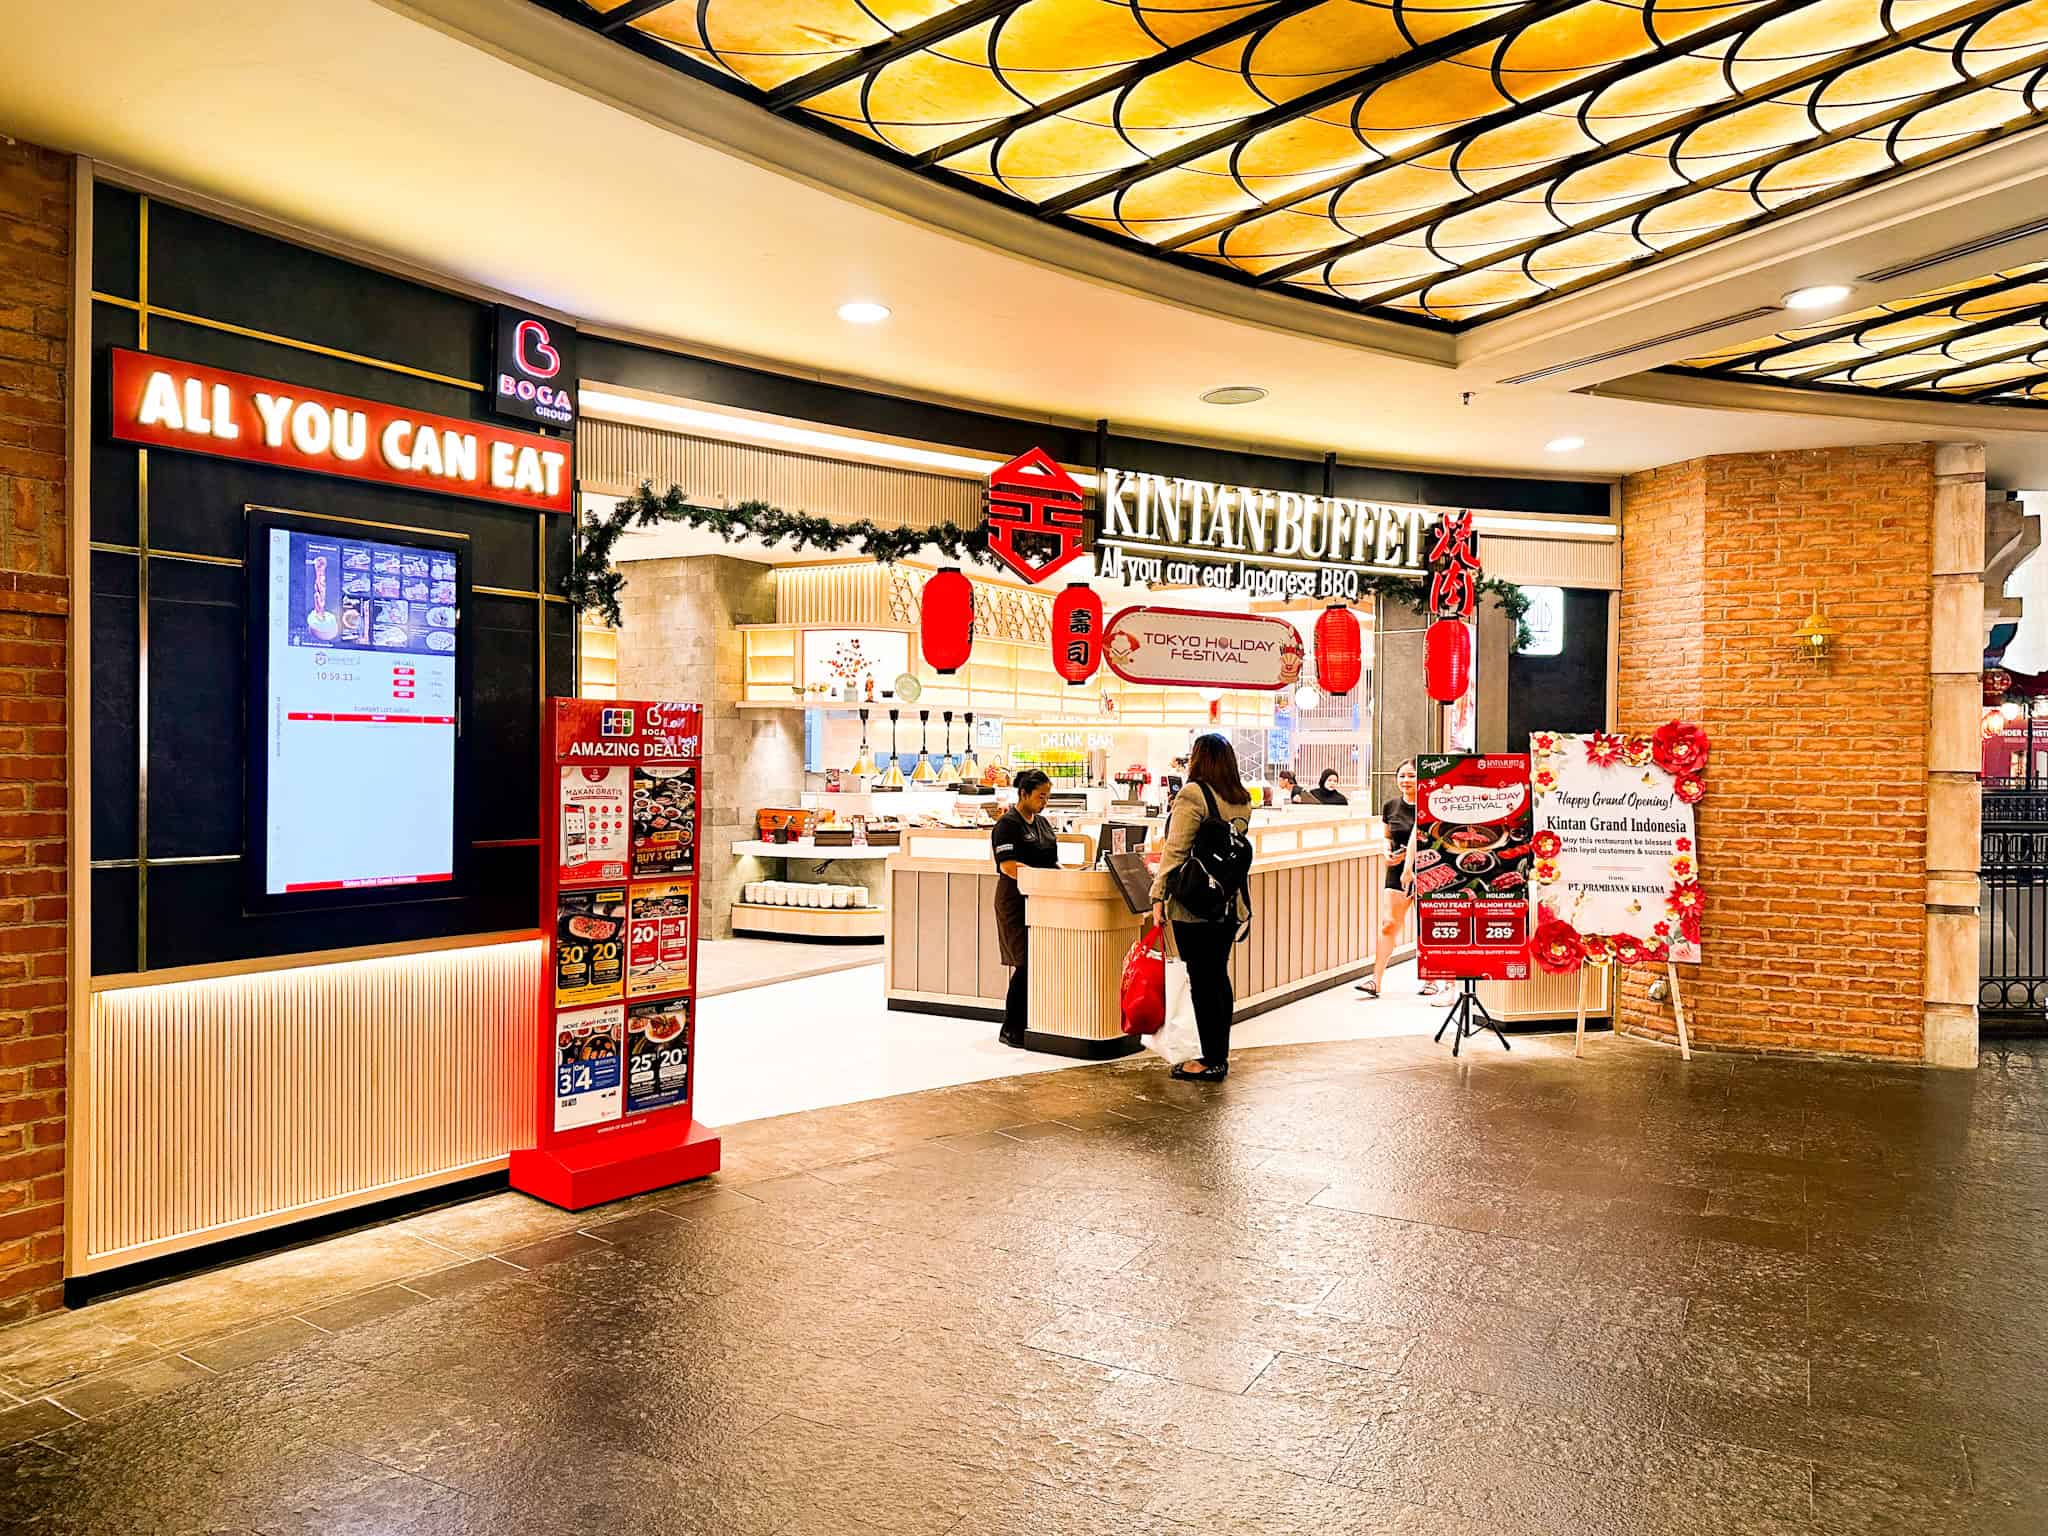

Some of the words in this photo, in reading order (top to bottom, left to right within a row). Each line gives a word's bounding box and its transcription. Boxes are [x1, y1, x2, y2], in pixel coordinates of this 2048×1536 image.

[499, 373, 572, 411] BOGA
[536, 405, 573, 422] GROUP
[138, 372, 240, 439] ALL
[255, 392, 367, 461] YOU
[382, 420, 477, 482] CAN
[491, 440, 565, 497] EAT
[1127, 557, 1161, 585] you
[1166, 562, 1200, 585] can
[1202, 562, 1234, 588] eat
[1237, 561, 1317, 597] Japanese
[1321, 568, 1359, 599] BBQ
[1143, 632, 1201, 647] TOKYO
[1205, 636, 1275, 652] HOLIDAY
[1170, 649, 1249, 664] FESTIVAL
[603, 717, 632, 728] JCB
[641, 728, 666, 737] BOGA
[1039, 732, 1084, 748] DRINK
[1087, 733, 1115, 748] BAR
[569, 742, 640, 757] AMAZING
[643, 743, 695, 758] DEALS!
[1432, 795, 1470, 804] TOKYO
[1472, 792, 1521, 801] HOLIDAY
[1450, 802, 1503, 811] FESTIVAL
[1555, 791, 1590, 809] Happy
[1592, 791, 1627, 807] Grand
[1627, 791, 1674, 811] Opening!
[1546, 816, 1587, 831] Kintan
[1590, 817, 1628, 832] Grand
[1631, 818, 1687, 833] Indonesia
[1562, 836, 1577, 845] May
[1580, 836, 1593, 844] this
[637, 851, 656, 863] BUY
[664, 849, 682, 861] GET
[1580, 846, 1597, 855] loyal
[1583, 883, 1629, 893] PRAMBANAN
[1631, 885, 1665, 894] KENCANA
[592, 942, 617, 961] 20
[630, 1055, 652, 1074] 25
[660, 1048, 683, 1068] 20
[559, 1074, 573, 1095] 3
[575, 1066, 593, 1091] 4
